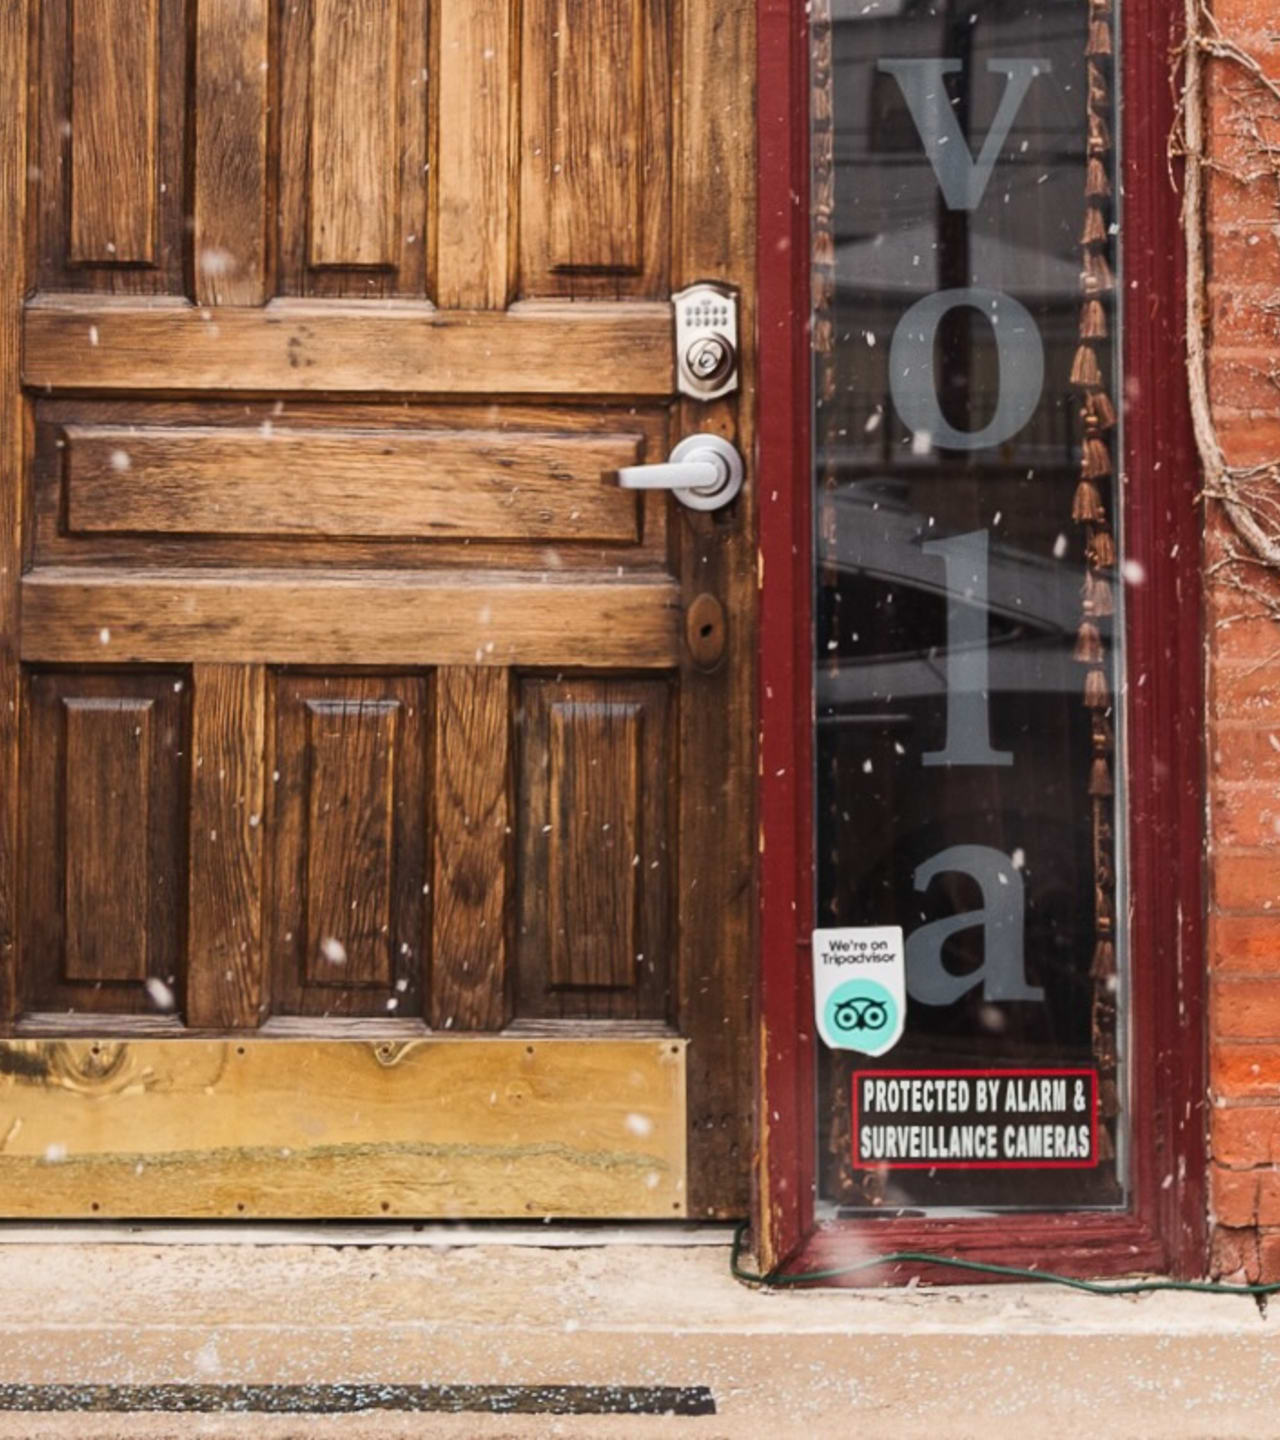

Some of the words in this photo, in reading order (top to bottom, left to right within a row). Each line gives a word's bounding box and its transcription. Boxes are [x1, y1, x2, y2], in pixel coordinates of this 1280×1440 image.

[828, 940, 868, 952] We're
[870, 940, 889, 951] on
[821, 951, 897, 967] Tripadvisor
[863, 1079, 970, 1113] PROTECTED
[975, 1079, 1001, 1112] BY
[1004, 1079, 1067, 1112] ALARM
[1073, 1079, 1087, 1112] &
[859, 1126, 998, 1158] SURVEILLANCE
[1002, 1125, 1091, 1158] CAMERAS
